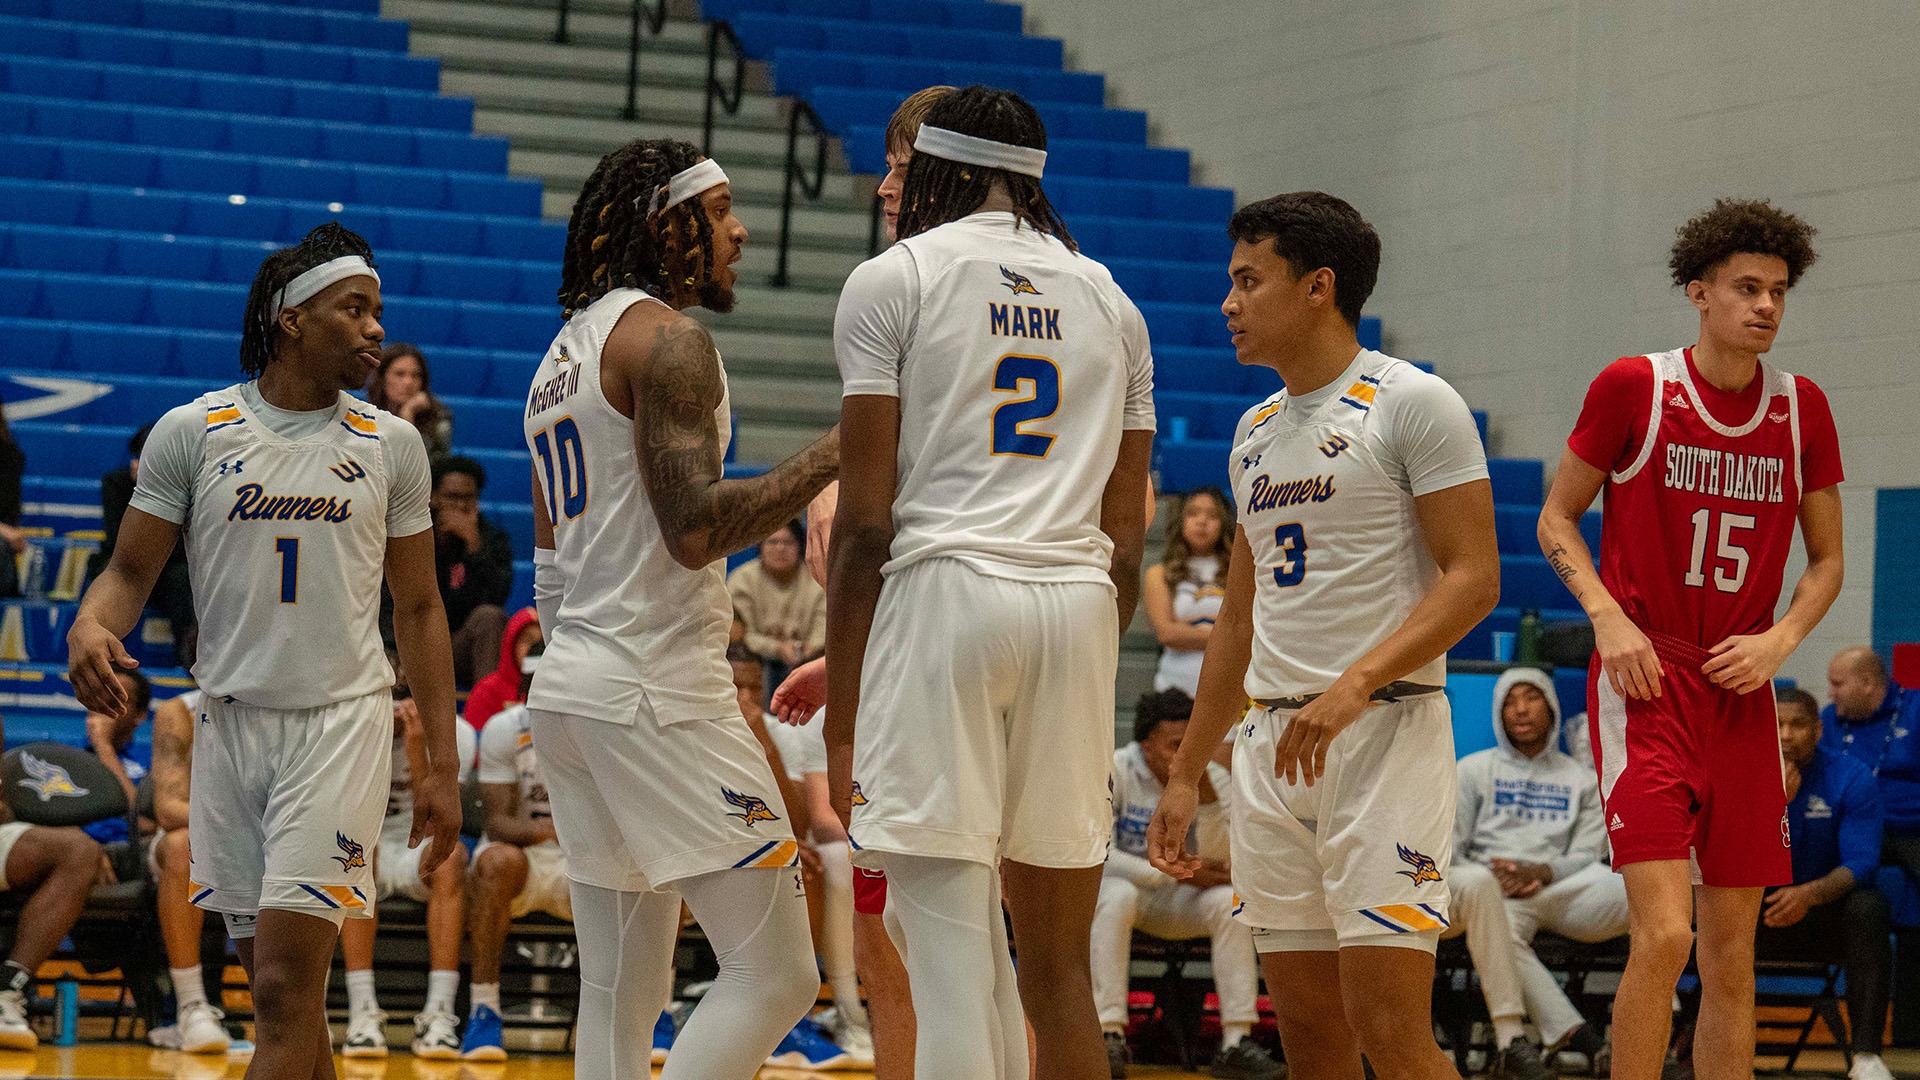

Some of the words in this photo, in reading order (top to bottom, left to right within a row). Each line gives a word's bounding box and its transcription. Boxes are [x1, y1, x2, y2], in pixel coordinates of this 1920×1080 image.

[989, 302, 1063, 341] MARK
[528, 370, 568, 419] McGHEE
[566, 362, 581, 398] III
[990, 352, 1062, 459] 2
[227, 483, 352, 523] Runners
[532, 414, 589, 529] 10
[1247, 474, 1336, 516] Runners
[1664, 442, 1722, 496] SOUTH
[1723, 452, 1784, 503] DAKOTA
[275, 536, 301, 604] 1
[1273, 521, 1308, 588] 3
[1684, 508, 1756, 593] 15
